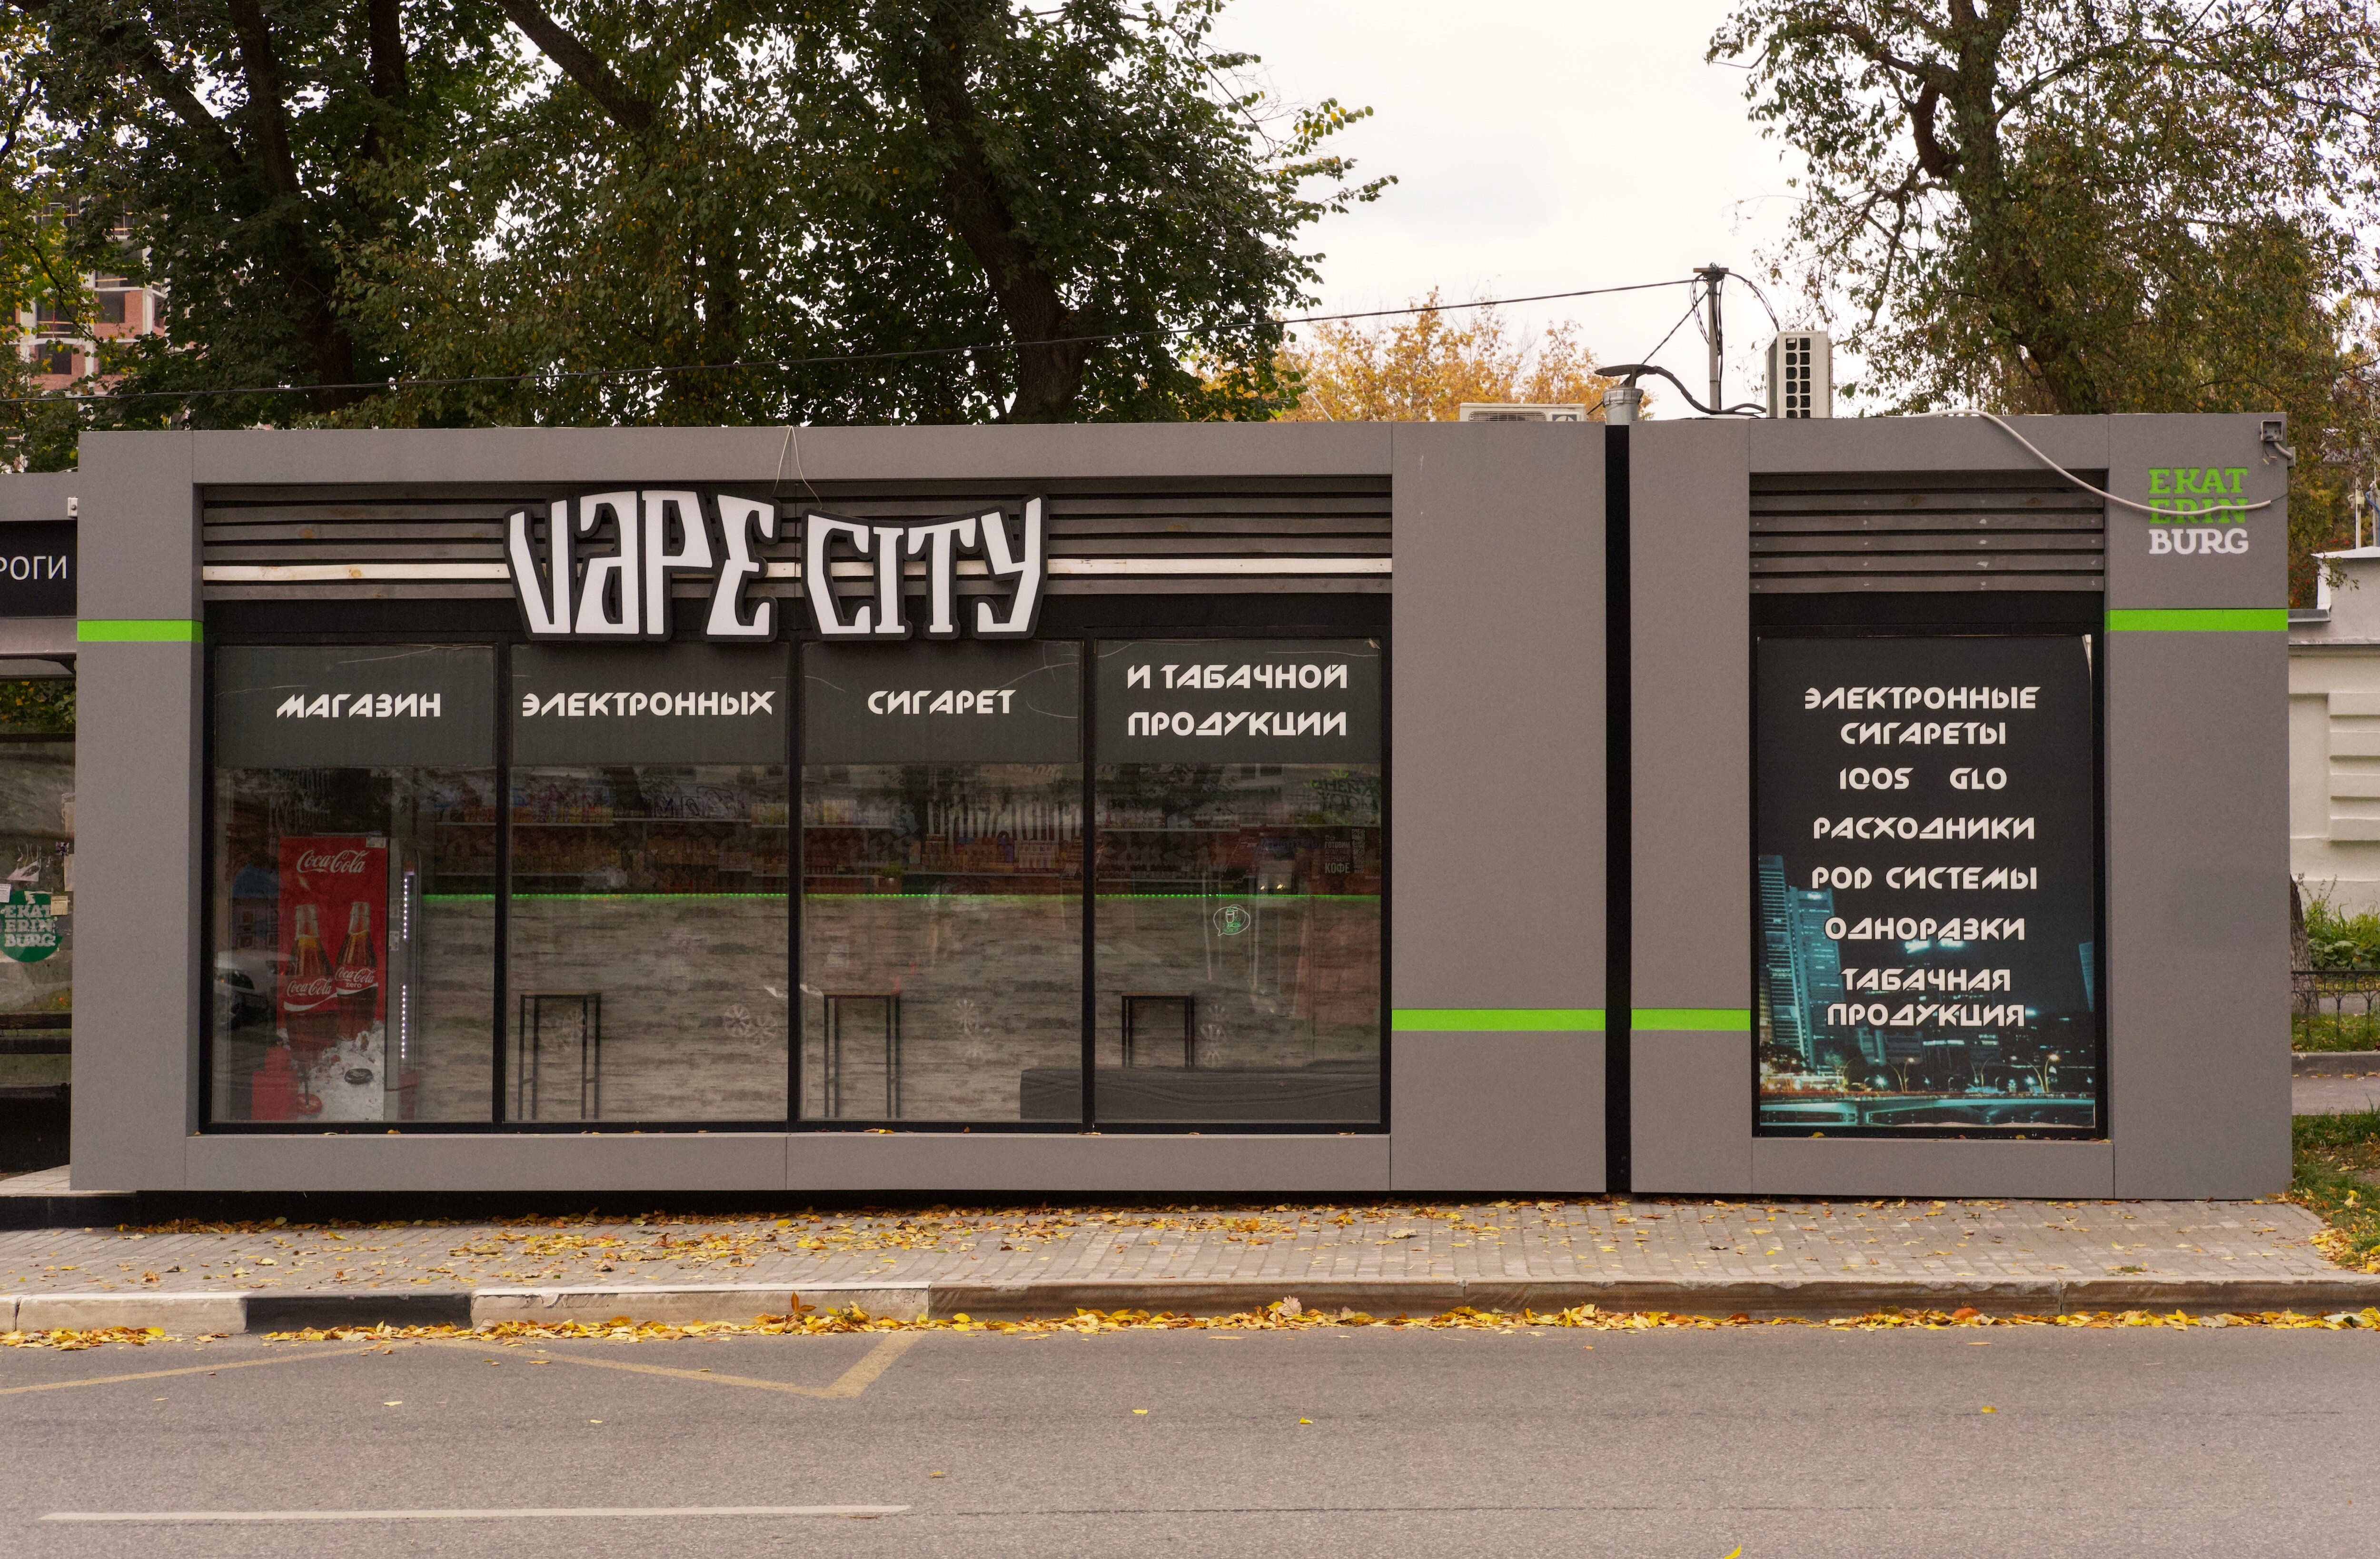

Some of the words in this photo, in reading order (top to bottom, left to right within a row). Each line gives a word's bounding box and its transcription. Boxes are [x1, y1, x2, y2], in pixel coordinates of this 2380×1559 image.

[2148, 467, 2248, 494] EKAT
[2148, 498, 2248, 523] ERIN
[2149, 528, 2249, 554] BURG
[807, 497, 1041, 635] CITY
[1128, 665, 1150, 689] И
[1160, 665, 1347, 689] ТАБАЧНОЙ
[277, 693, 440, 718] МАГАЗИН
[523, 691, 775, 716] ЭЛЕКТРОННЫХ
[868, 690, 1016, 715] СИГАРЕТ
[1805, 686, 2041, 709] ЭЛЕКТРОННЫЕ
[1128, 712, 1346, 736] ПРОДУКЦИИ
[1840, 722, 2005, 745] СИГАРЕТЫ
[1840, 767, 1914, 790] IQOS
[1950, 767, 2007, 790] GLO
[1814, 817, 2034, 839] РАСХОДНИКИ
[296, 849, 369, 873] Coca-Cola
[1325, 863, 1350, 874] КОФЕ
[1812, 866, 1872, 889] POD
[1886, 866, 2037, 889] СИСТЕМЫ
[4, 919, 55, 933] ERIN
[1825, 917, 2025, 940] ОДНОРАЗКИ
[4, 934, 56, 947] BURG
[335, 967, 376, 983] Coca-Cola
[1841, 968, 2010, 991] ТАБАЧНАЯ
[287, 978, 333, 997] Coca-Cola
[1827, 1003, 2025, 1026] ПРОДУКЦИЯ
